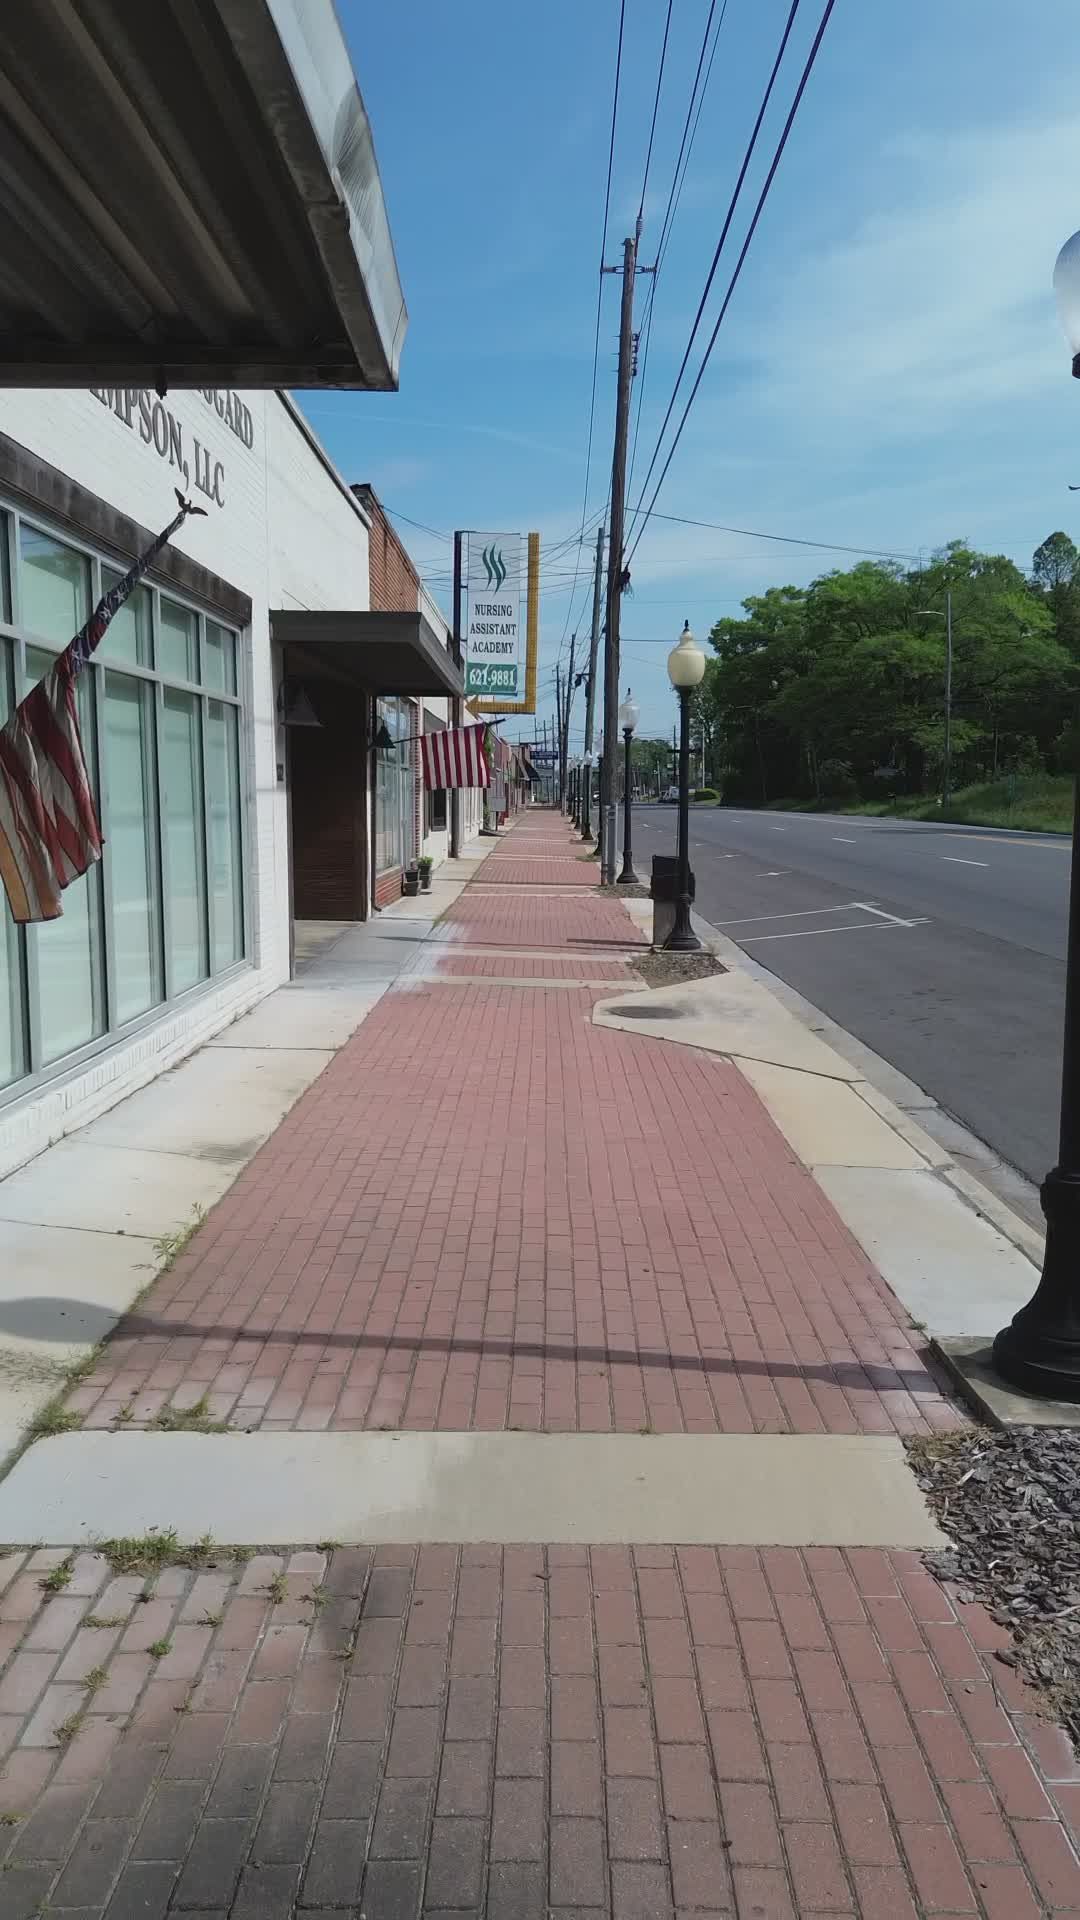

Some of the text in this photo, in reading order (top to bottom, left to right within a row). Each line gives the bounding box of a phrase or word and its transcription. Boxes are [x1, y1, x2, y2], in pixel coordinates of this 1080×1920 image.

[193, 438, 225, 508] LLC
[474, 603, 513, 617] NURSING
[469, 623, 517, 636] ASSISTANT
[472, 641, 514, 654] ACADEMY
[469, 668, 515, 687] 621-9881
